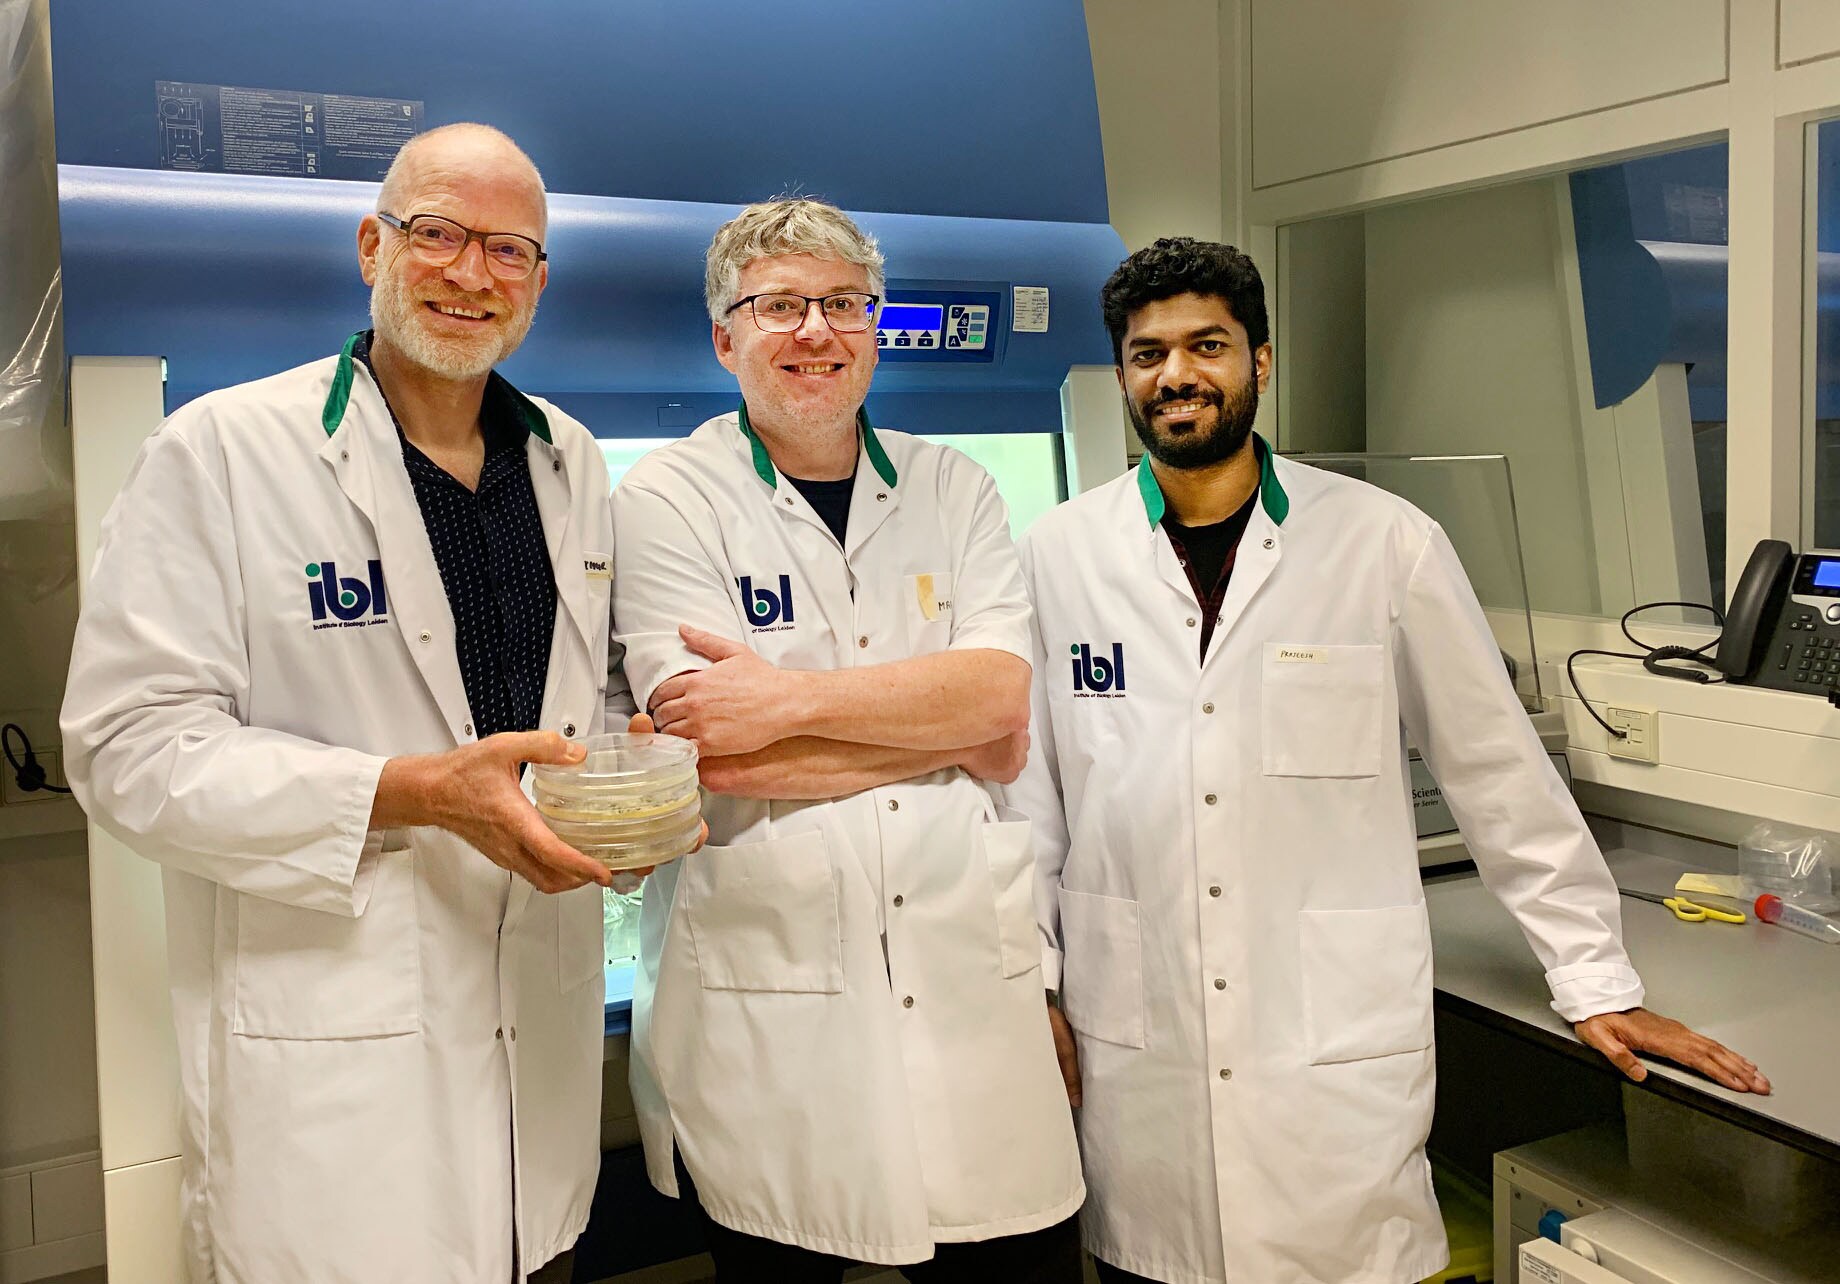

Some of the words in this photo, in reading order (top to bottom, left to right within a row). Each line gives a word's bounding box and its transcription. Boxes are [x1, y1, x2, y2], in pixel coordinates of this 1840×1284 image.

[305, 560, 387, 621] ibl
[735, 575, 794, 627] bl
[313, 622, 338, 631] Institute
[344, 620, 366, 628] Biology
[367, 618, 389, 626] Leiden
[1070, 643, 1126, 693] ibl
